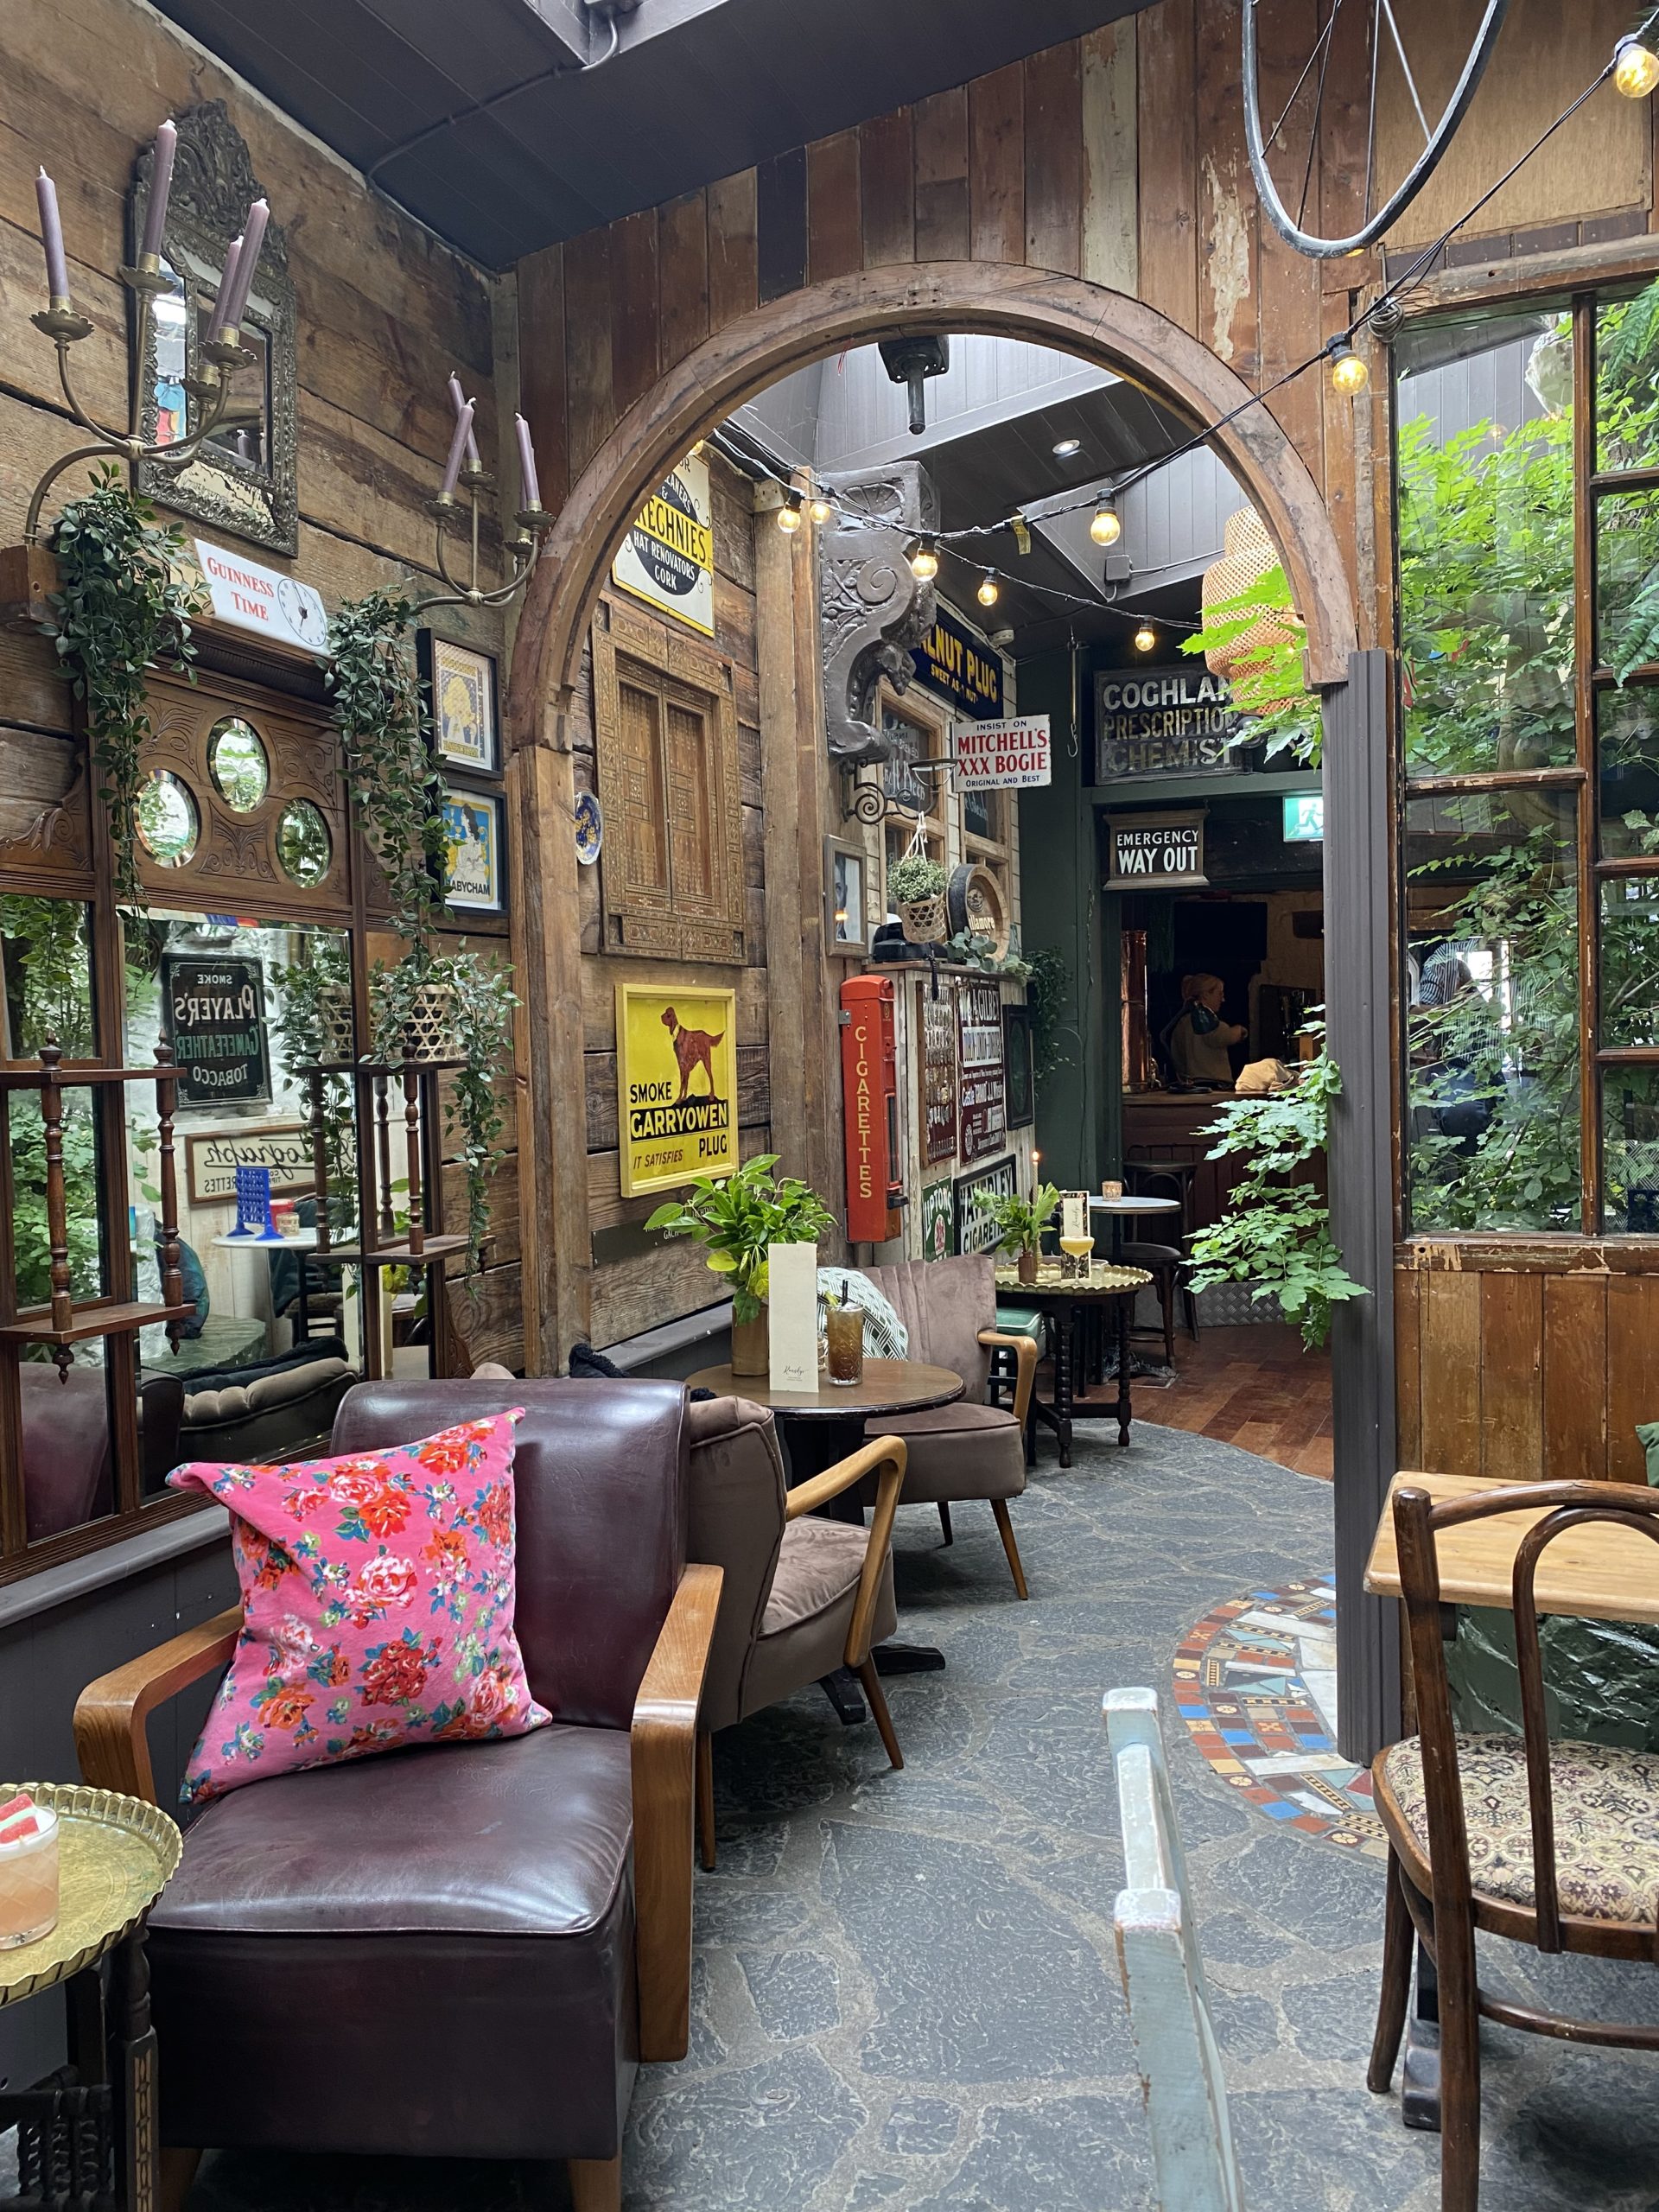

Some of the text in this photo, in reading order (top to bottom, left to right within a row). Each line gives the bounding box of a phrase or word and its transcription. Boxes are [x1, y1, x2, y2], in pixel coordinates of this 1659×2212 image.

[633, 531, 695, 582] HAT RENOVATORS
[207, 556, 274, 598] GUINNESS
[654, 565, 677, 591] CORK
[231, 591, 269, 621] TIME
[931, 663, 950, 686] SWEET
[951, 677, 960, 693] AS
[966, 649, 998, 703] PLUG
[976, 722, 1007, 731] INSIST
[1103, 706, 1238, 741] PRESCRIPTION
[958, 728, 1047, 754] MITCHELL'S
[1107, 736, 1231, 772] CHEMIST
[958, 752, 1047, 777] XXX BOGIE
[966, 778, 1000, 787] ORIGINAL
[1021, 774, 1039, 783] BEST
[1116, 830, 1198, 846] EMERGENCY
[1118, 845, 1198, 874] WAY OUT
[451, 879, 490, 896] ABYCHAM
[630, 1081, 672, 1103] SMOKE
[631, 1103, 727, 1139] GARRYOWEN
[855, 1026, 872, 1198] CIGARETTES
[633, 1148, 683, 1170] IT SATISFIES
[699, 1134, 727, 1158] PLUG
